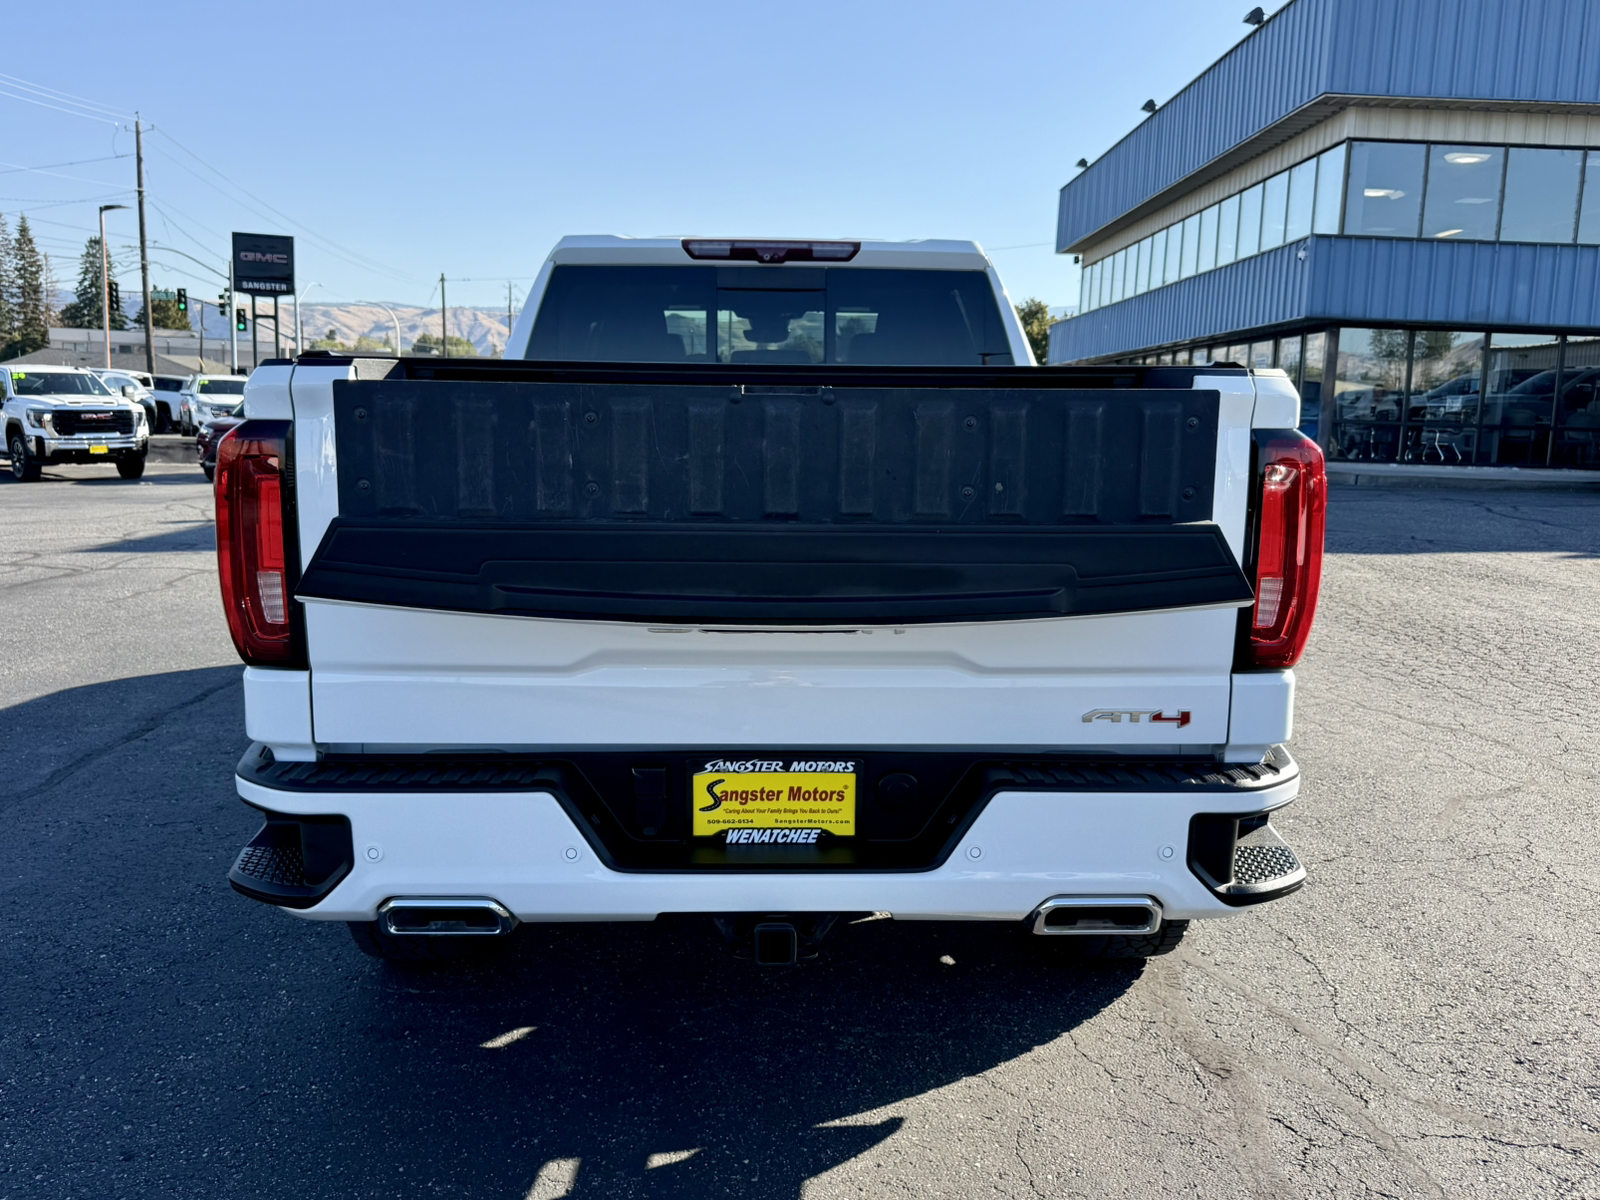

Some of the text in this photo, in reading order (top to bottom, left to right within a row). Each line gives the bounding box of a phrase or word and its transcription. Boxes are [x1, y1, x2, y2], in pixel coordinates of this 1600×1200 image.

[240, 251, 288, 264] GMC
[241, 280, 287, 291] SANGSTER
[1082, 708, 1191, 729] AT4
[697, 759, 855, 774] SANGSTER MOTORS
[698, 778, 783, 812] Sangster
[725, 829, 821, 844] WENATCHEE
